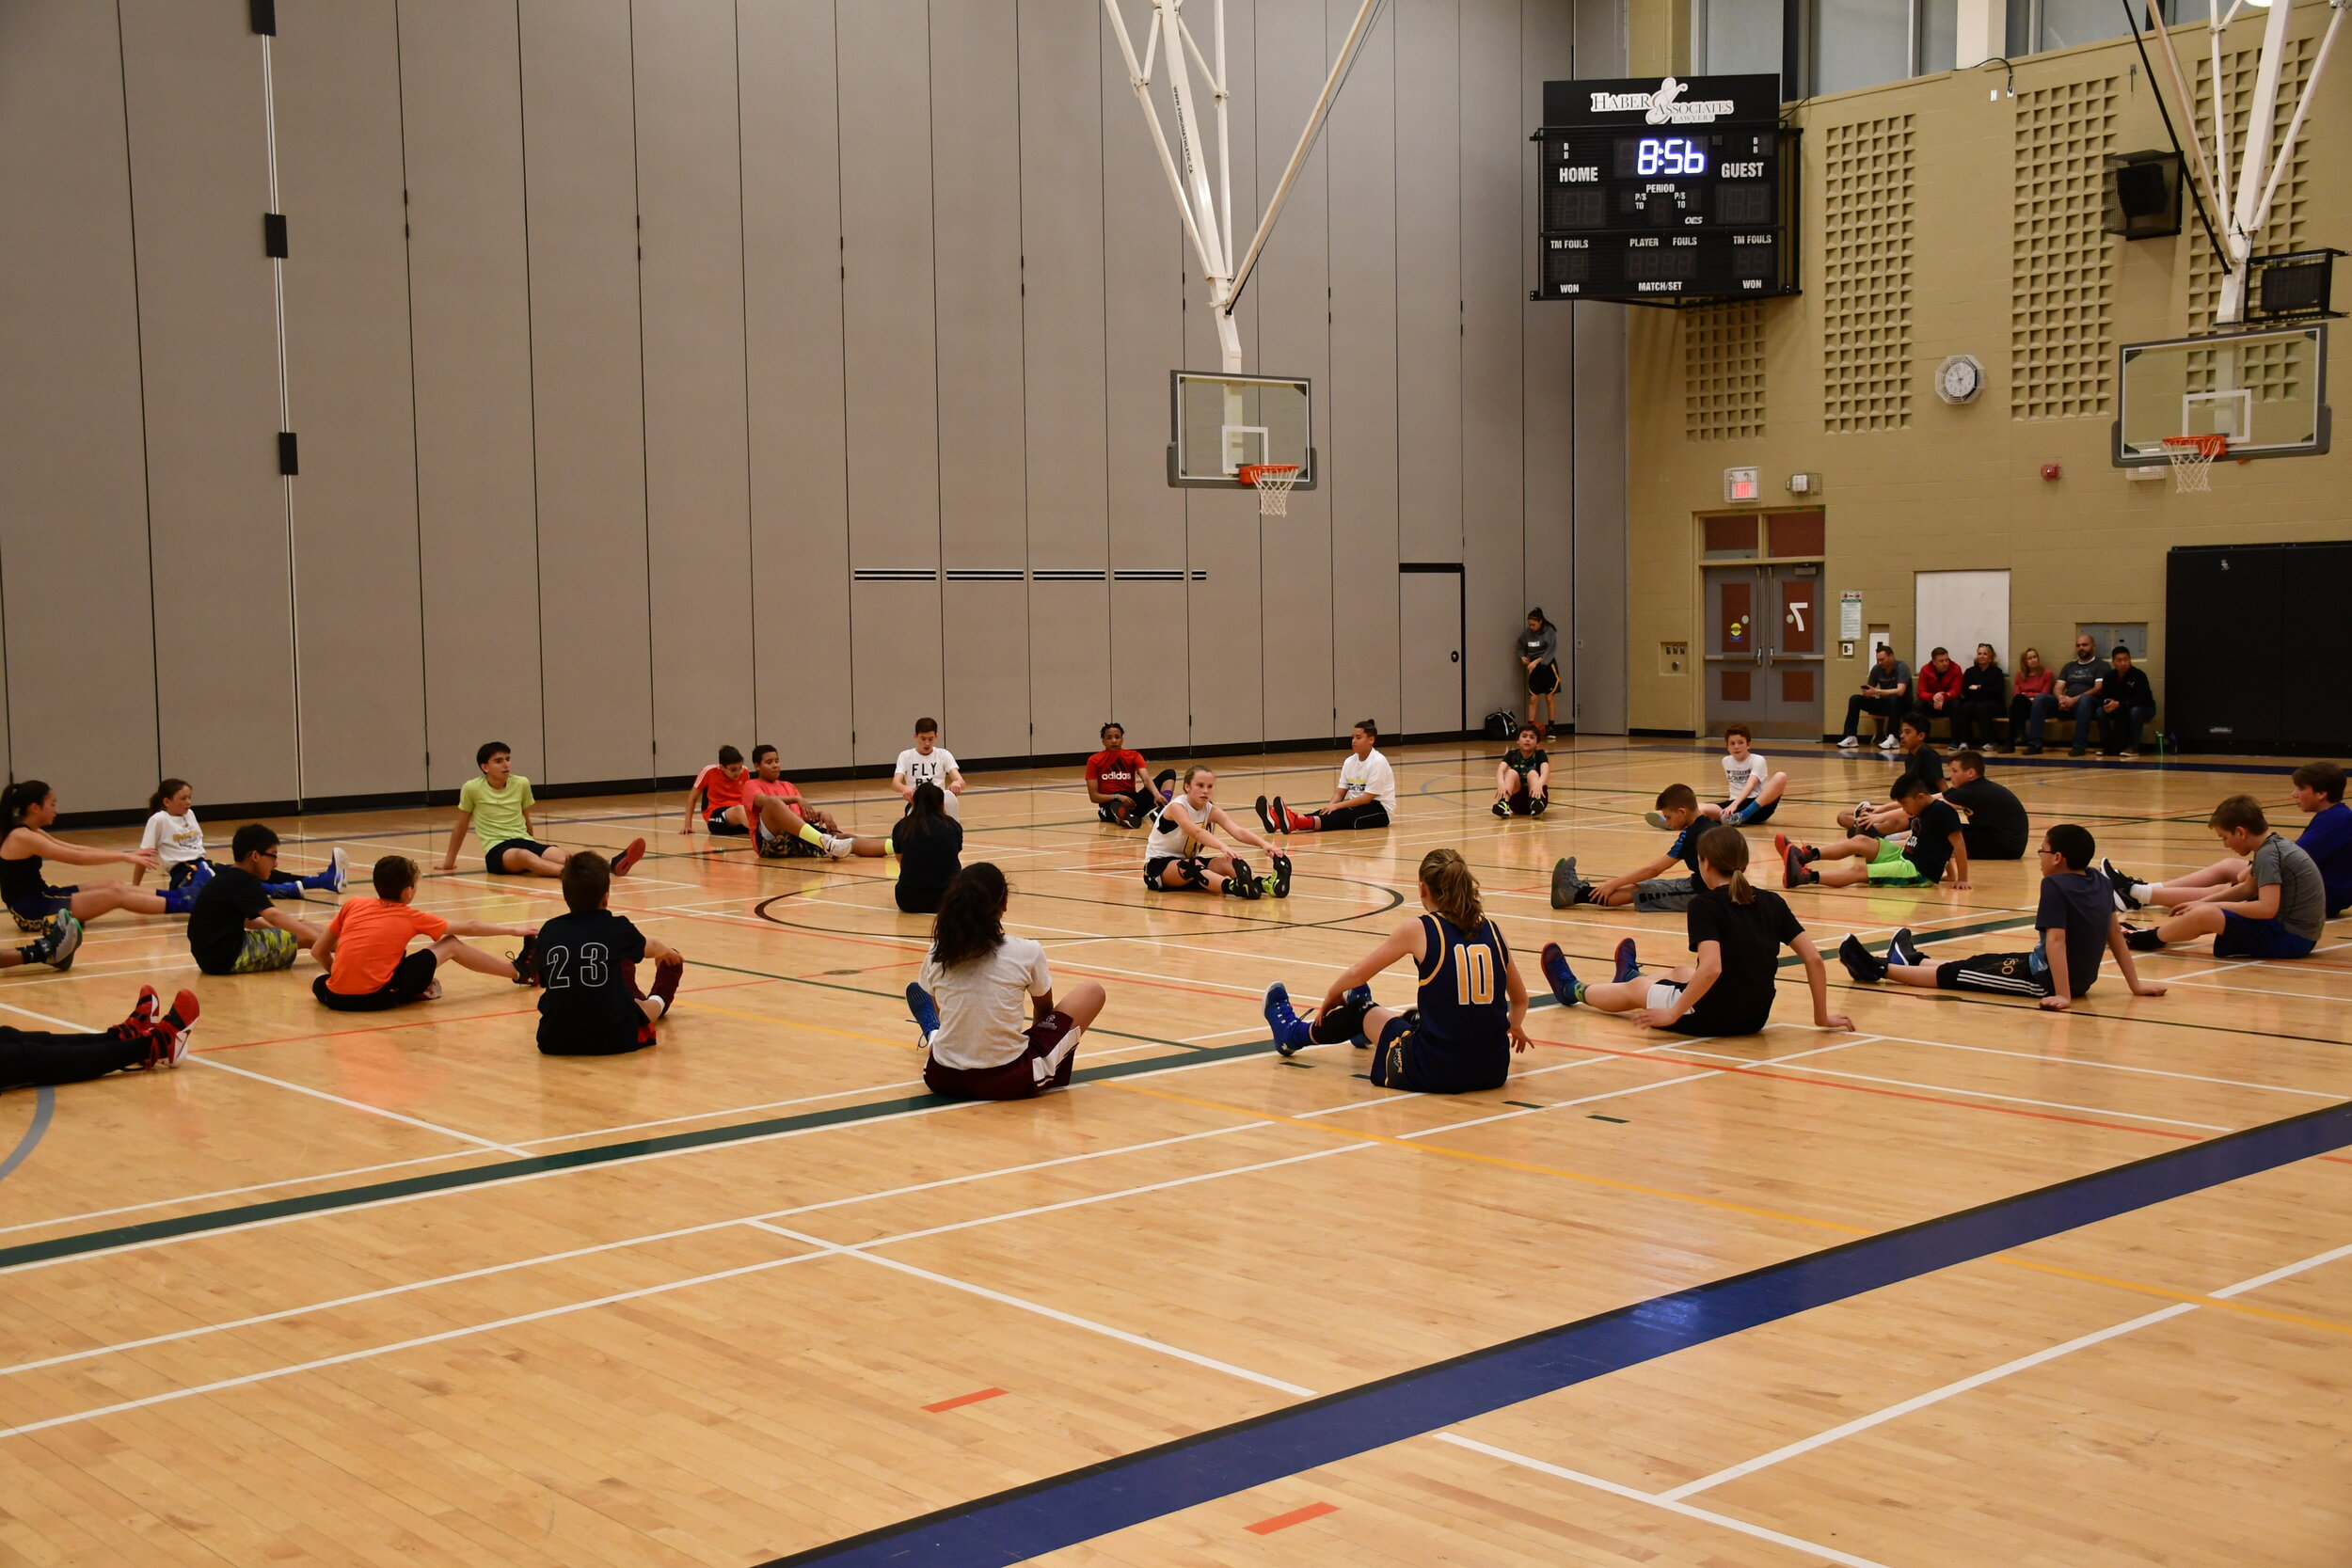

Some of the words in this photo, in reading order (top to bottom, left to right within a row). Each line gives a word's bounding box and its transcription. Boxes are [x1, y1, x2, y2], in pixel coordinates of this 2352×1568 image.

[1593, 95, 1650, 109] HABER
[1655, 103, 1733, 115] ASSOCIATES
[1638, 139, 1704, 175] 8:56
[1559, 167, 1598, 182] HOME
[1721, 162, 1764, 178] GUEST
[1645, 183, 1675, 193] PERIOD
[1635, 201, 1645, 210] TO
[1550, 240, 1563, 248] TM
[1564, 240, 1589, 248] FOULS
[1629, 238, 1660, 246] PLAYER
[1673, 237, 1697, 245] FOULS
[1733, 235, 1745, 245] TM
[1747, 235, 1772, 244] FOULS
[1560, 284, 1580, 293] WON
[1638, 282, 1683, 292] MATCH/SET
[1742, 279, 1762, 289] WON
[912, 762, 937, 776] FLY
[1102, 771, 1132, 780] adidas
[547, 942, 609, 989] 23
[1454, 943, 1494, 1006] 10
